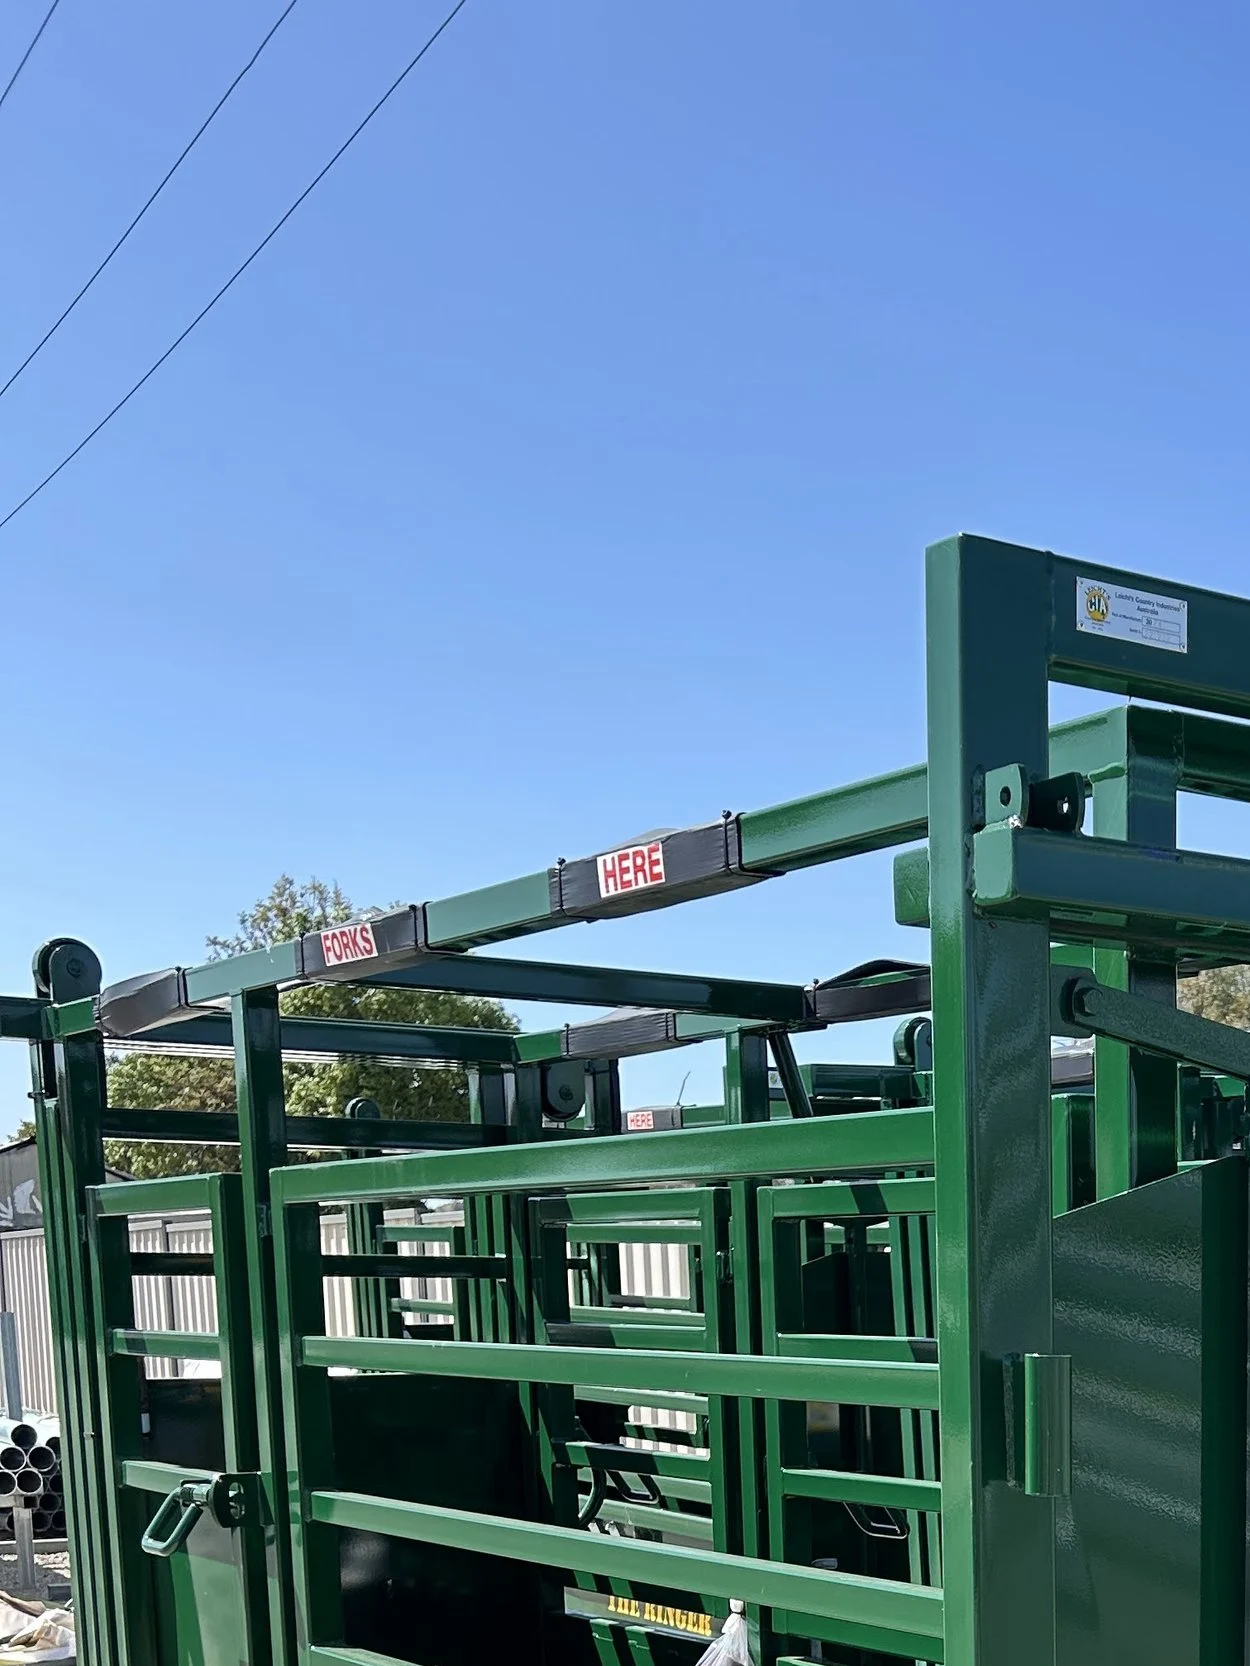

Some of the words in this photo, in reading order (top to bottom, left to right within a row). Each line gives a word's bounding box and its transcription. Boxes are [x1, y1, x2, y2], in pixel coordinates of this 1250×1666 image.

[602, 843, 662, 893] HERE
[322, 925, 374, 964] FORKS
[629, 1113, 653, 1128] HERE
[607, 1595, 640, 1618] THE
[643, 1604, 713, 1636] RINGER
